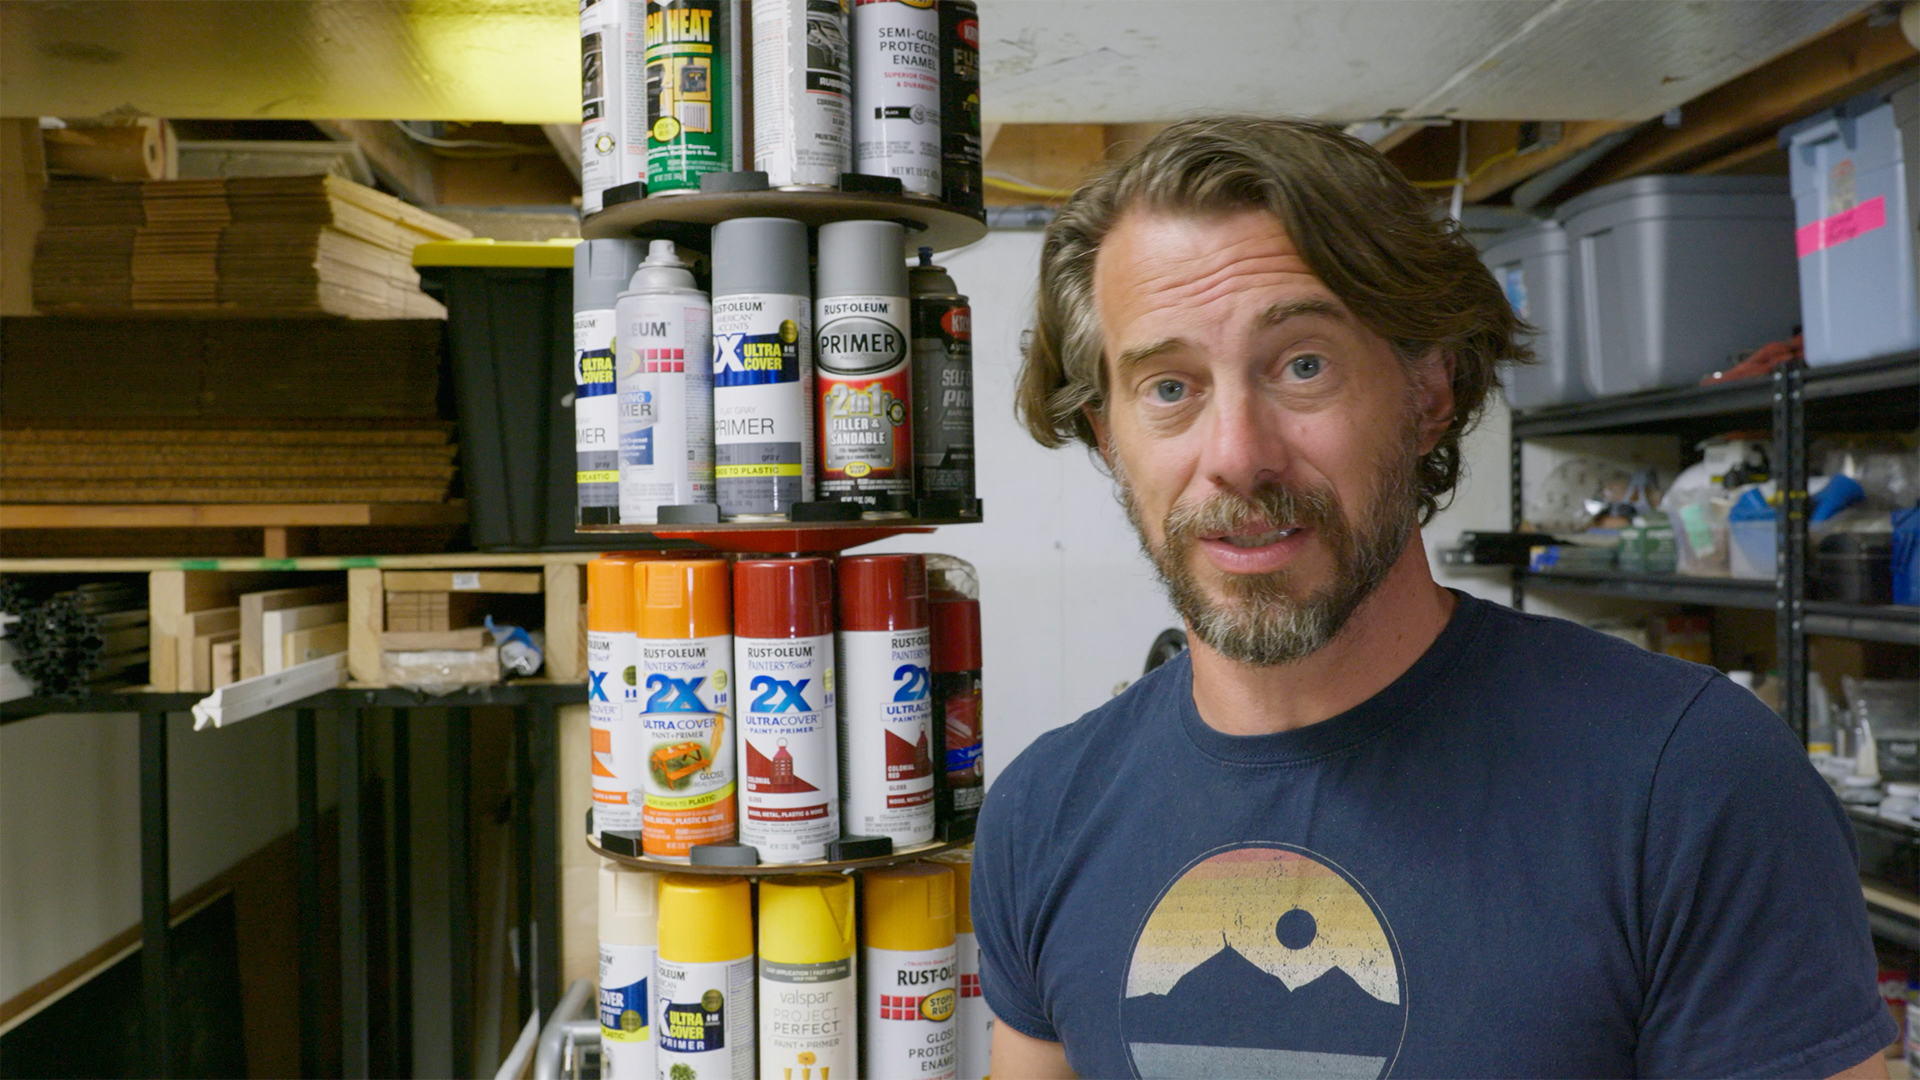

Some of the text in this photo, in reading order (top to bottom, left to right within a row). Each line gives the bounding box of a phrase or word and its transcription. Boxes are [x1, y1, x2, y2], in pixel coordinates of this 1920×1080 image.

[666, 8, 712, 42] HEAT
[893, 54, 937, 71] ENAMEL
[884, 71, 917, 80] SUPERIOR
[824, 302, 889, 316] RUST-OLEUM
[743, 343, 782, 358] ULTRA
[820, 332, 896, 355] PRIMER
[582, 356, 613, 371] ULTRA
[743, 356, 783, 371] COVER
[582, 370, 614, 384] COVER
[832, 417, 880, 431] FILLER &
[830, 431, 886, 446] SANDABLE
[761, 454, 780, 463] gray
[582, 472, 610, 481] PLASTIC
[729, 466, 739, 475] TO
[741, 465, 780, 475] PLASTIC
[644, 647, 706, 659] RUST-OLEUM
[747, 646, 813, 658] RUST-OLEUM
[680, 659, 706, 671] Touch
[786, 659, 813, 670] Touch
[645, 672, 708, 713] 2X
[749, 674, 813, 713] 2X
[652, 731, 670, 739] PAINT
[675, 730, 704, 739] PRIMER
[749, 727, 773, 735] PAINT
[779, 726, 814, 735] PRIMER
[699, 770, 724, 781] GLOSS
[887, 764, 915, 773] COLONIAL
[688, 795, 716, 806] PLASTIC
[780, 989, 833, 1008] valspar
[930, 993, 954, 1008] STOPS
[773, 1007, 840, 1023] PROJECT
[932, 1003, 952, 1016] RUST
[669, 1010, 704, 1027] ULTRA
[670, 1025, 705, 1040] COVER
[774, 1020, 840, 1035] PERFECT
[662, 1039, 705, 1051] PRIMER
[774, 1039, 798, 1049] PAINT
[806, 1038, 840, 1049] PRIMER
